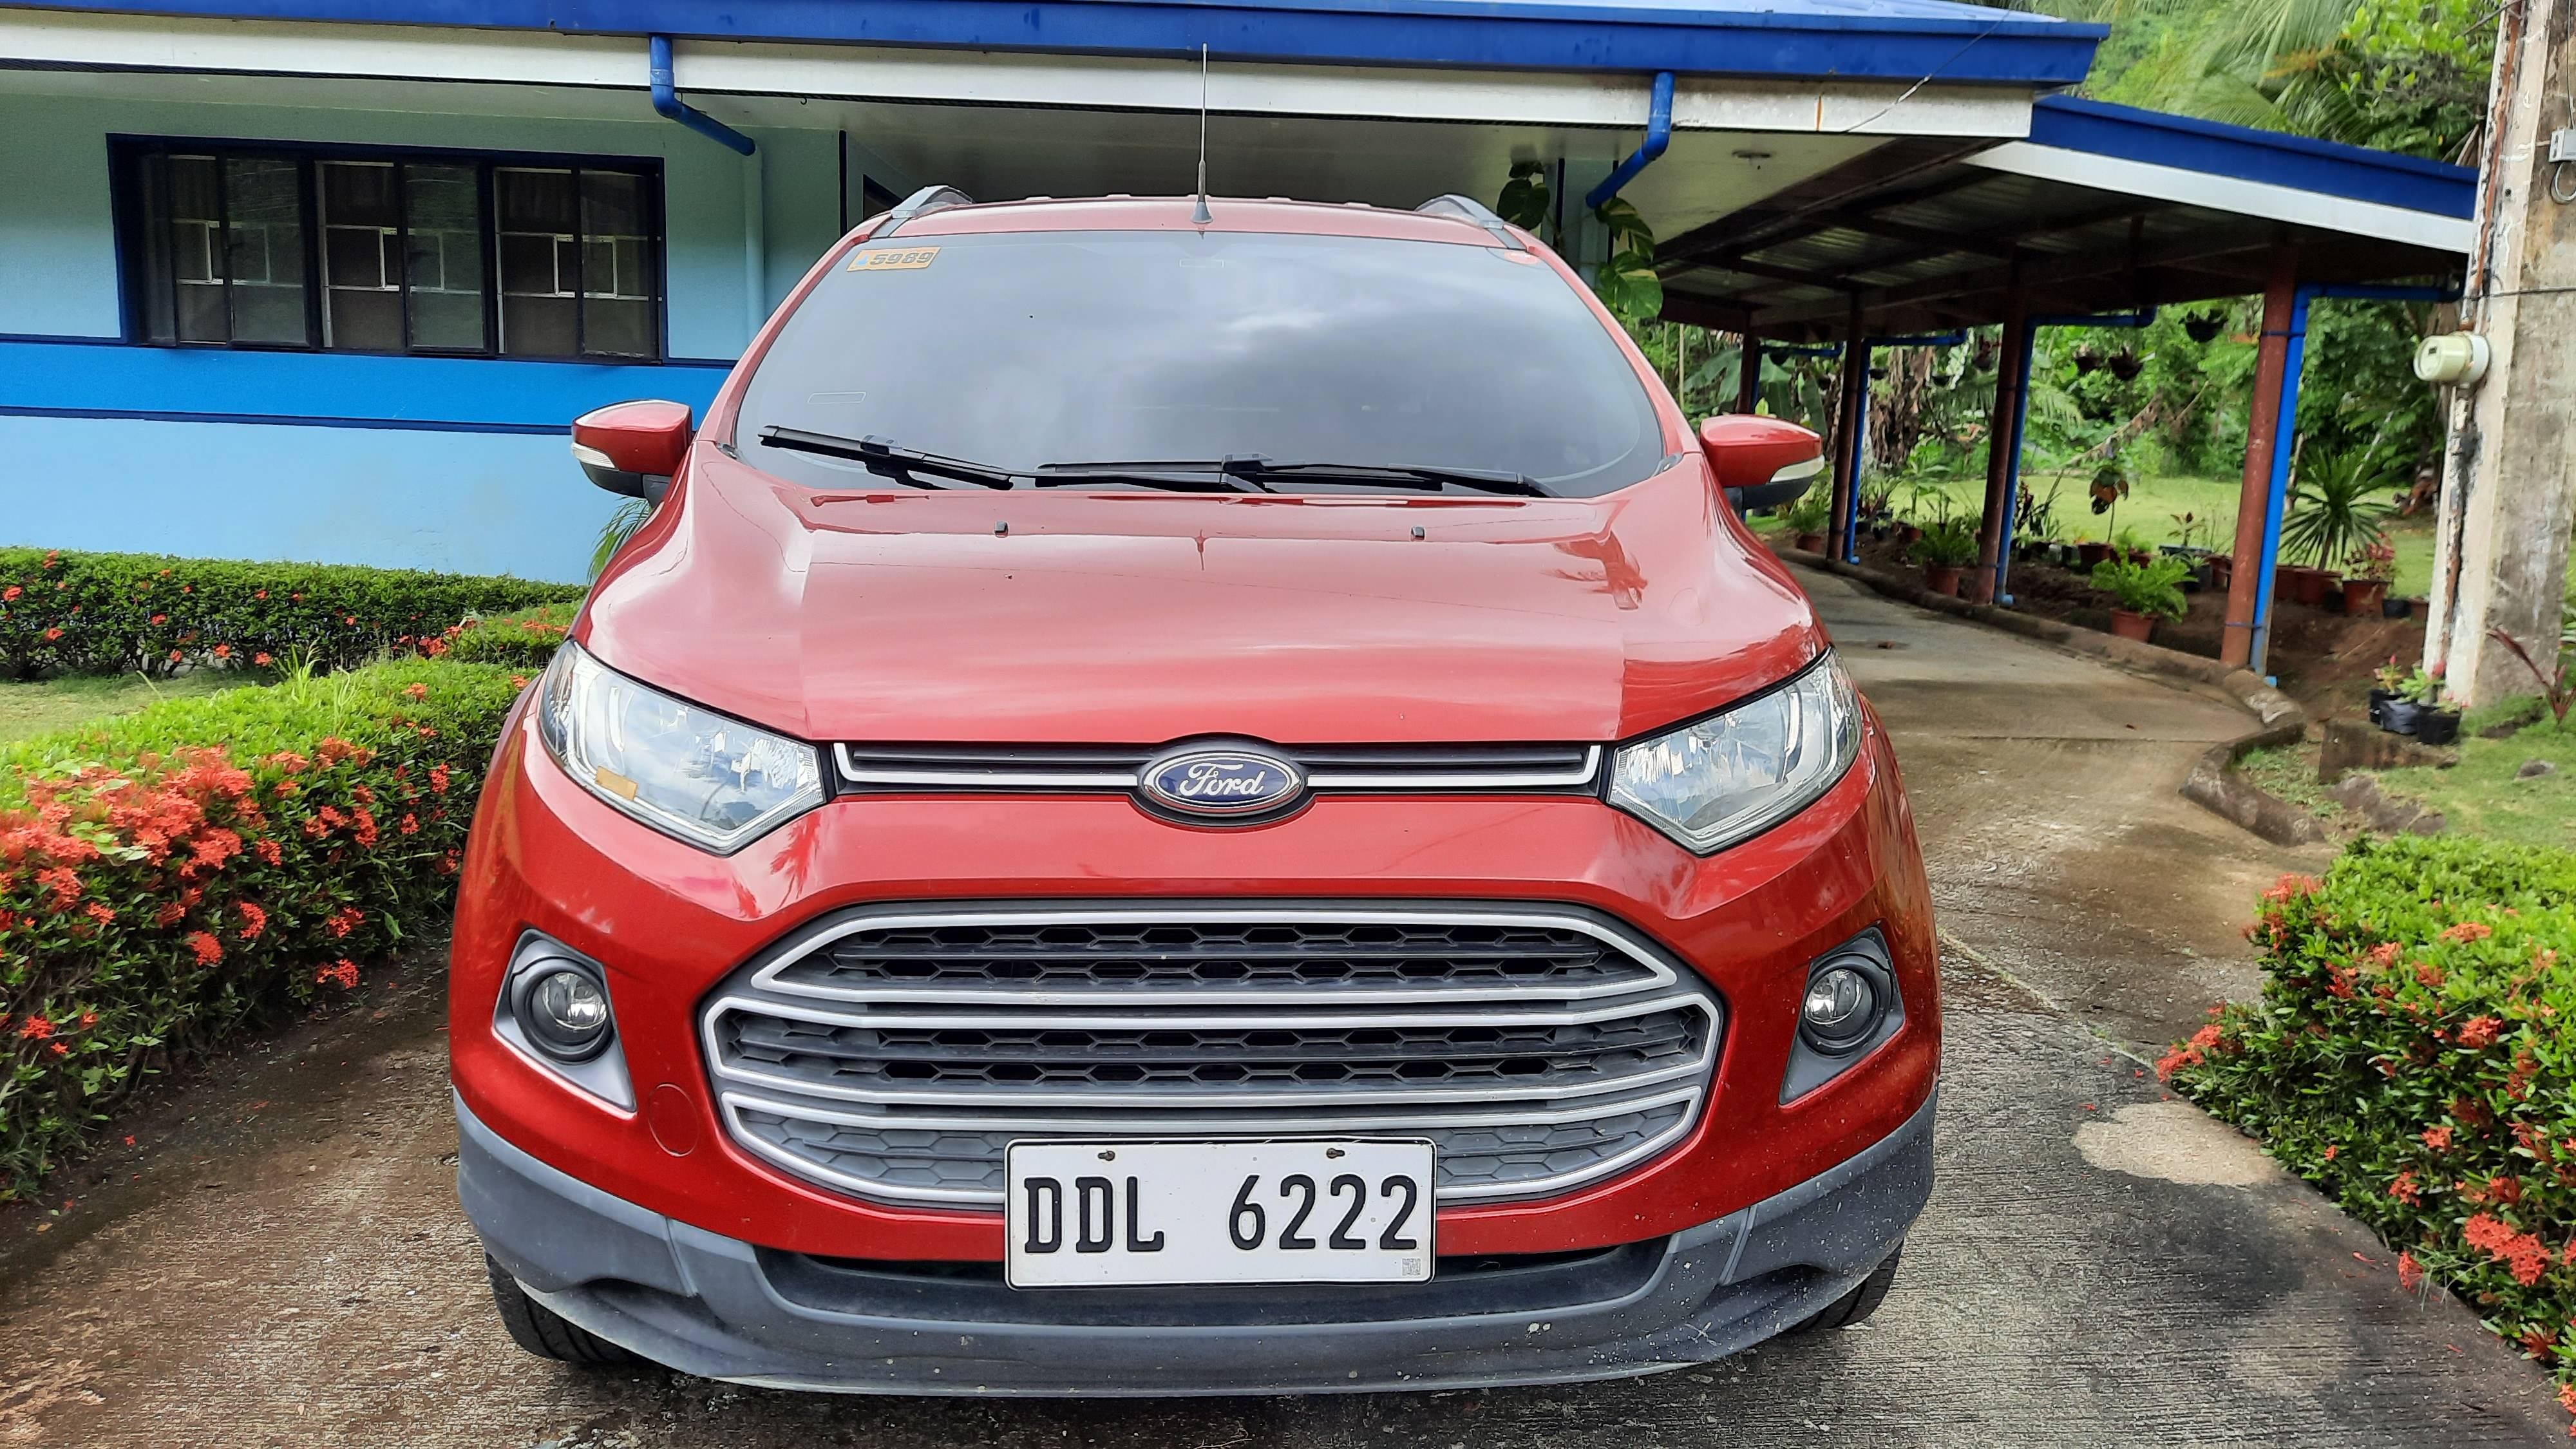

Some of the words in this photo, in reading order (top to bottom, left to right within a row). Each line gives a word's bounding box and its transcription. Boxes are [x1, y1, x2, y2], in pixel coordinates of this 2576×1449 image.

[1179, 762, 1265, 795] Ford
[1024, 1176, 1164, 1253] DDL
[1229, 1174, 1417, 1250] 6222
